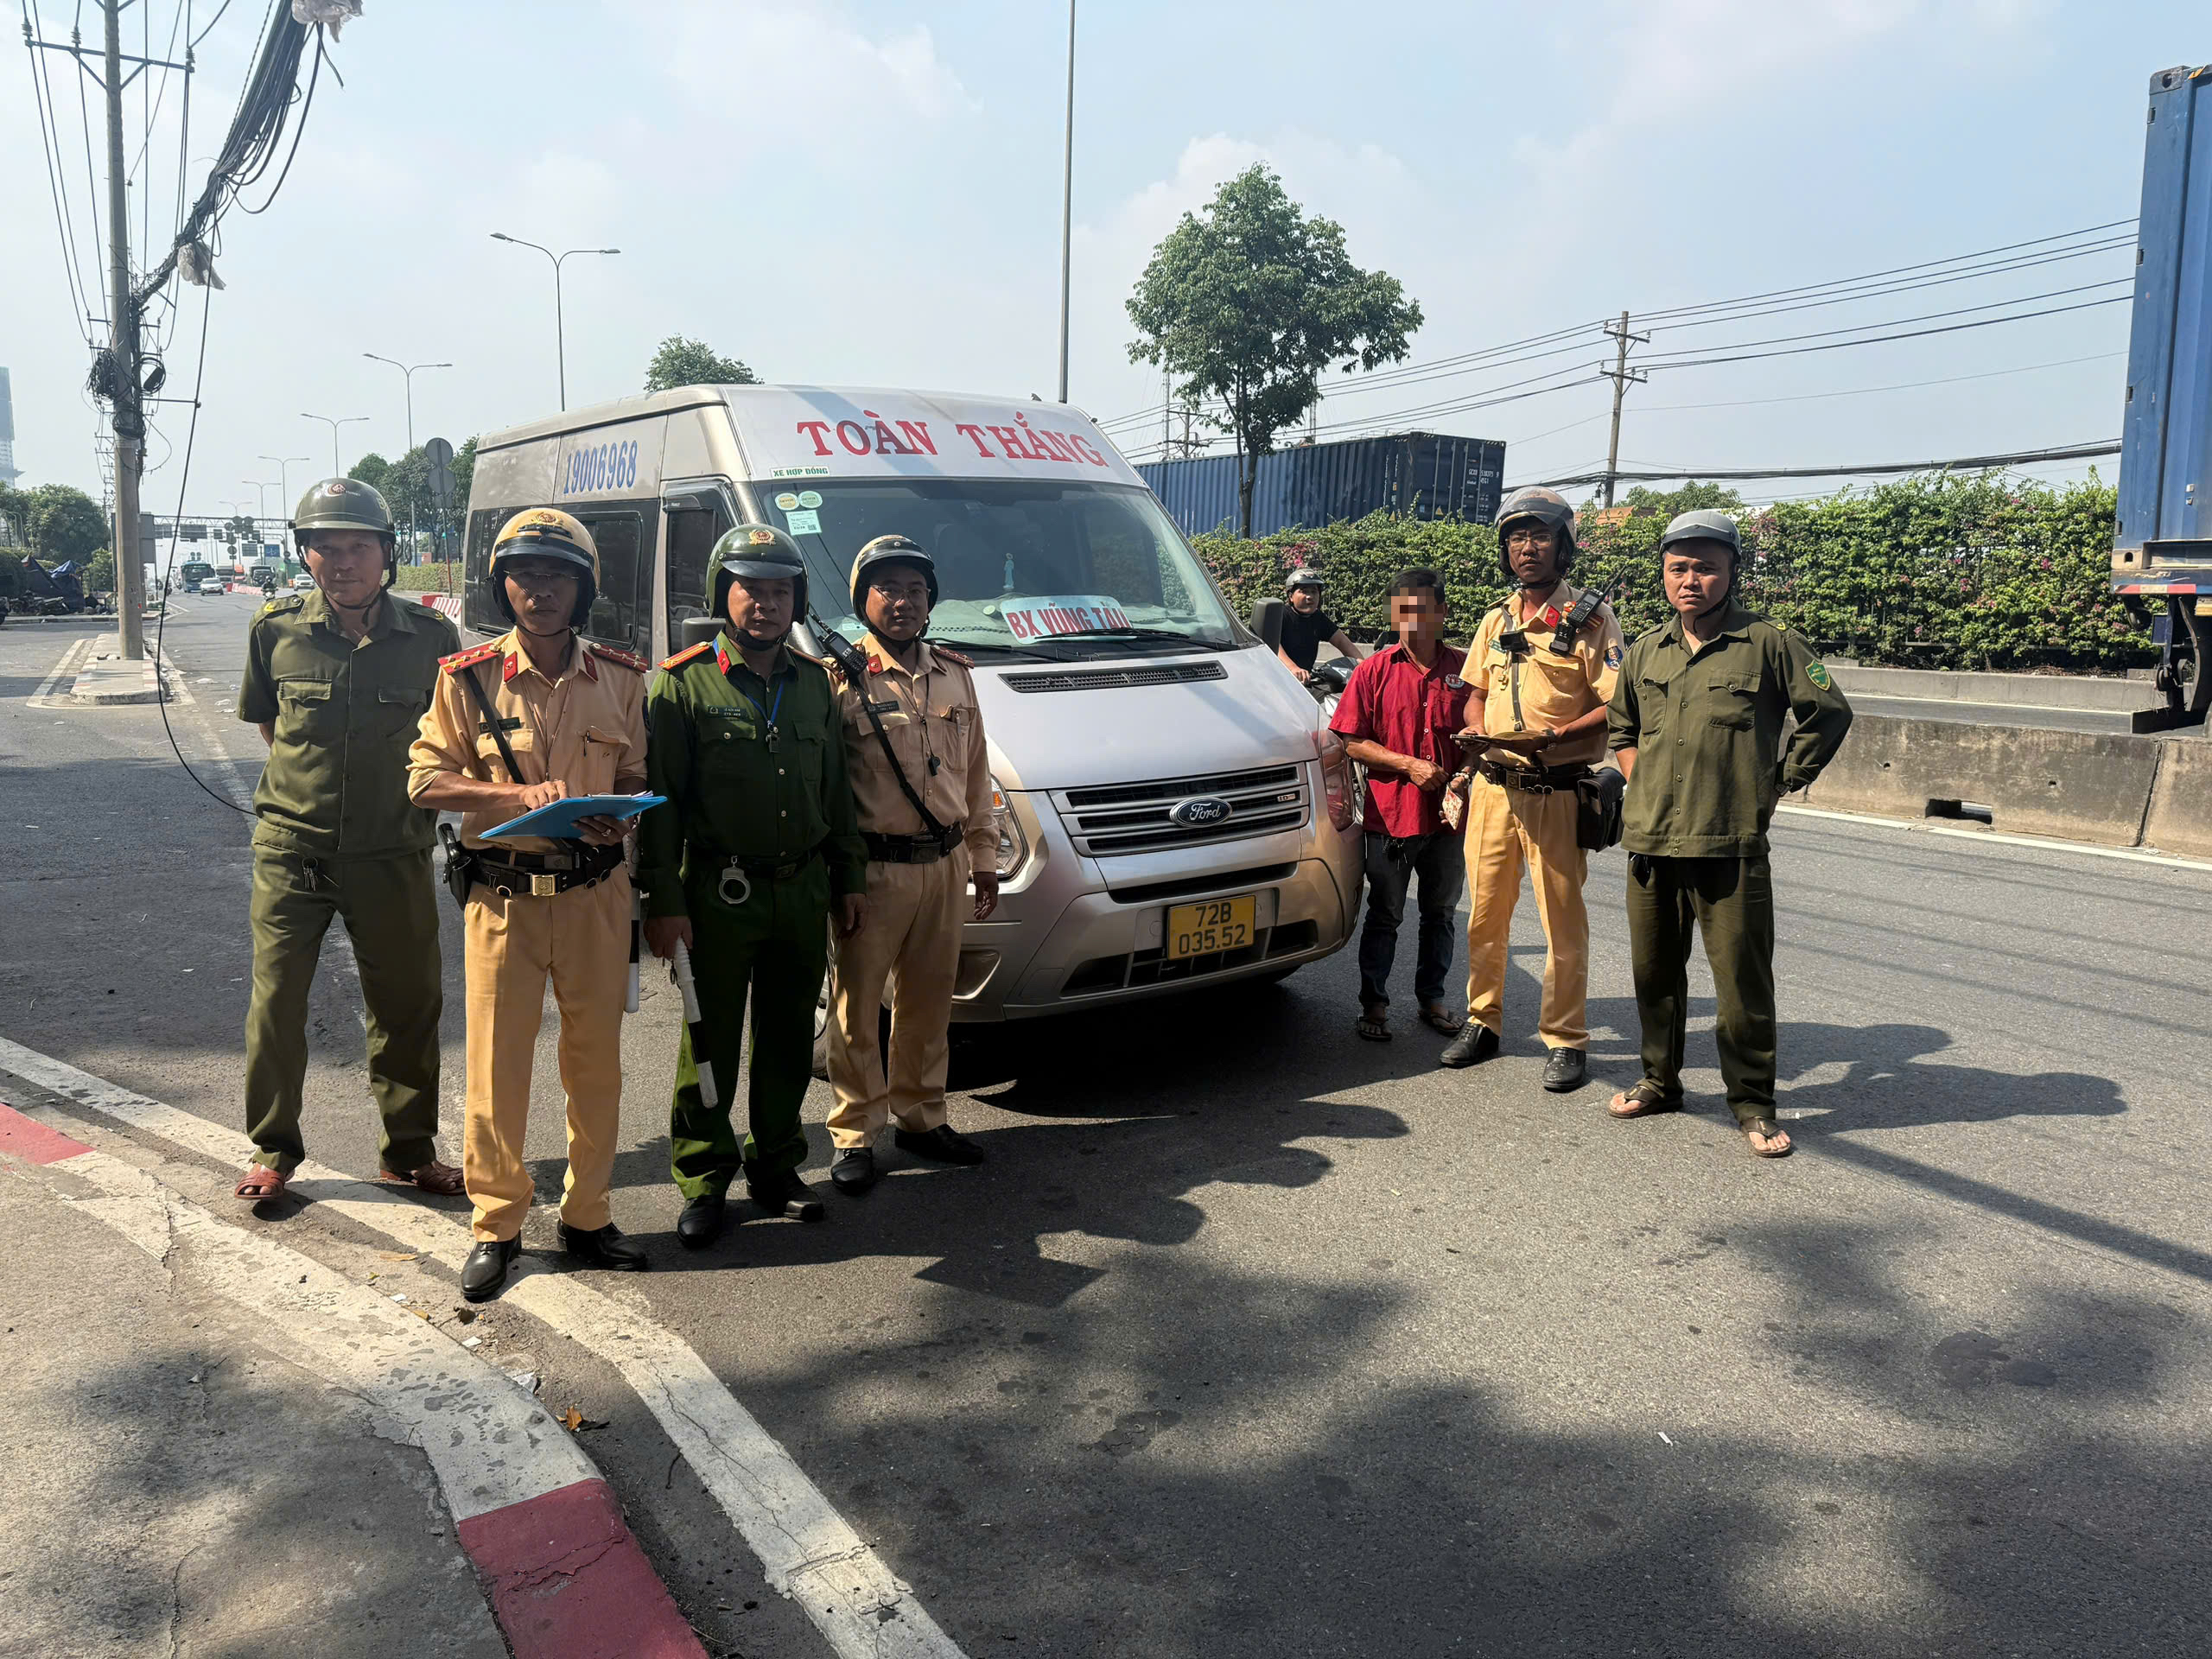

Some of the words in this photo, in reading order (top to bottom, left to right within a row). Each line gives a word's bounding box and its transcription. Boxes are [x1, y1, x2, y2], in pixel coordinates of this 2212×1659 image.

[796, 409, 939, 456] TOÀN
[954, 410, 1109, 467] THẮNG
[563, 439, 638, 494] 19006968
[1006, 609, 1043, 639] BX
[1037, 601, 1095, 636] VŨNG
[1189, 802, 1222, 821] Ford
[1195, 901, 1232, 928] 72B
[1179, 923, 1245, 956] 035.52
